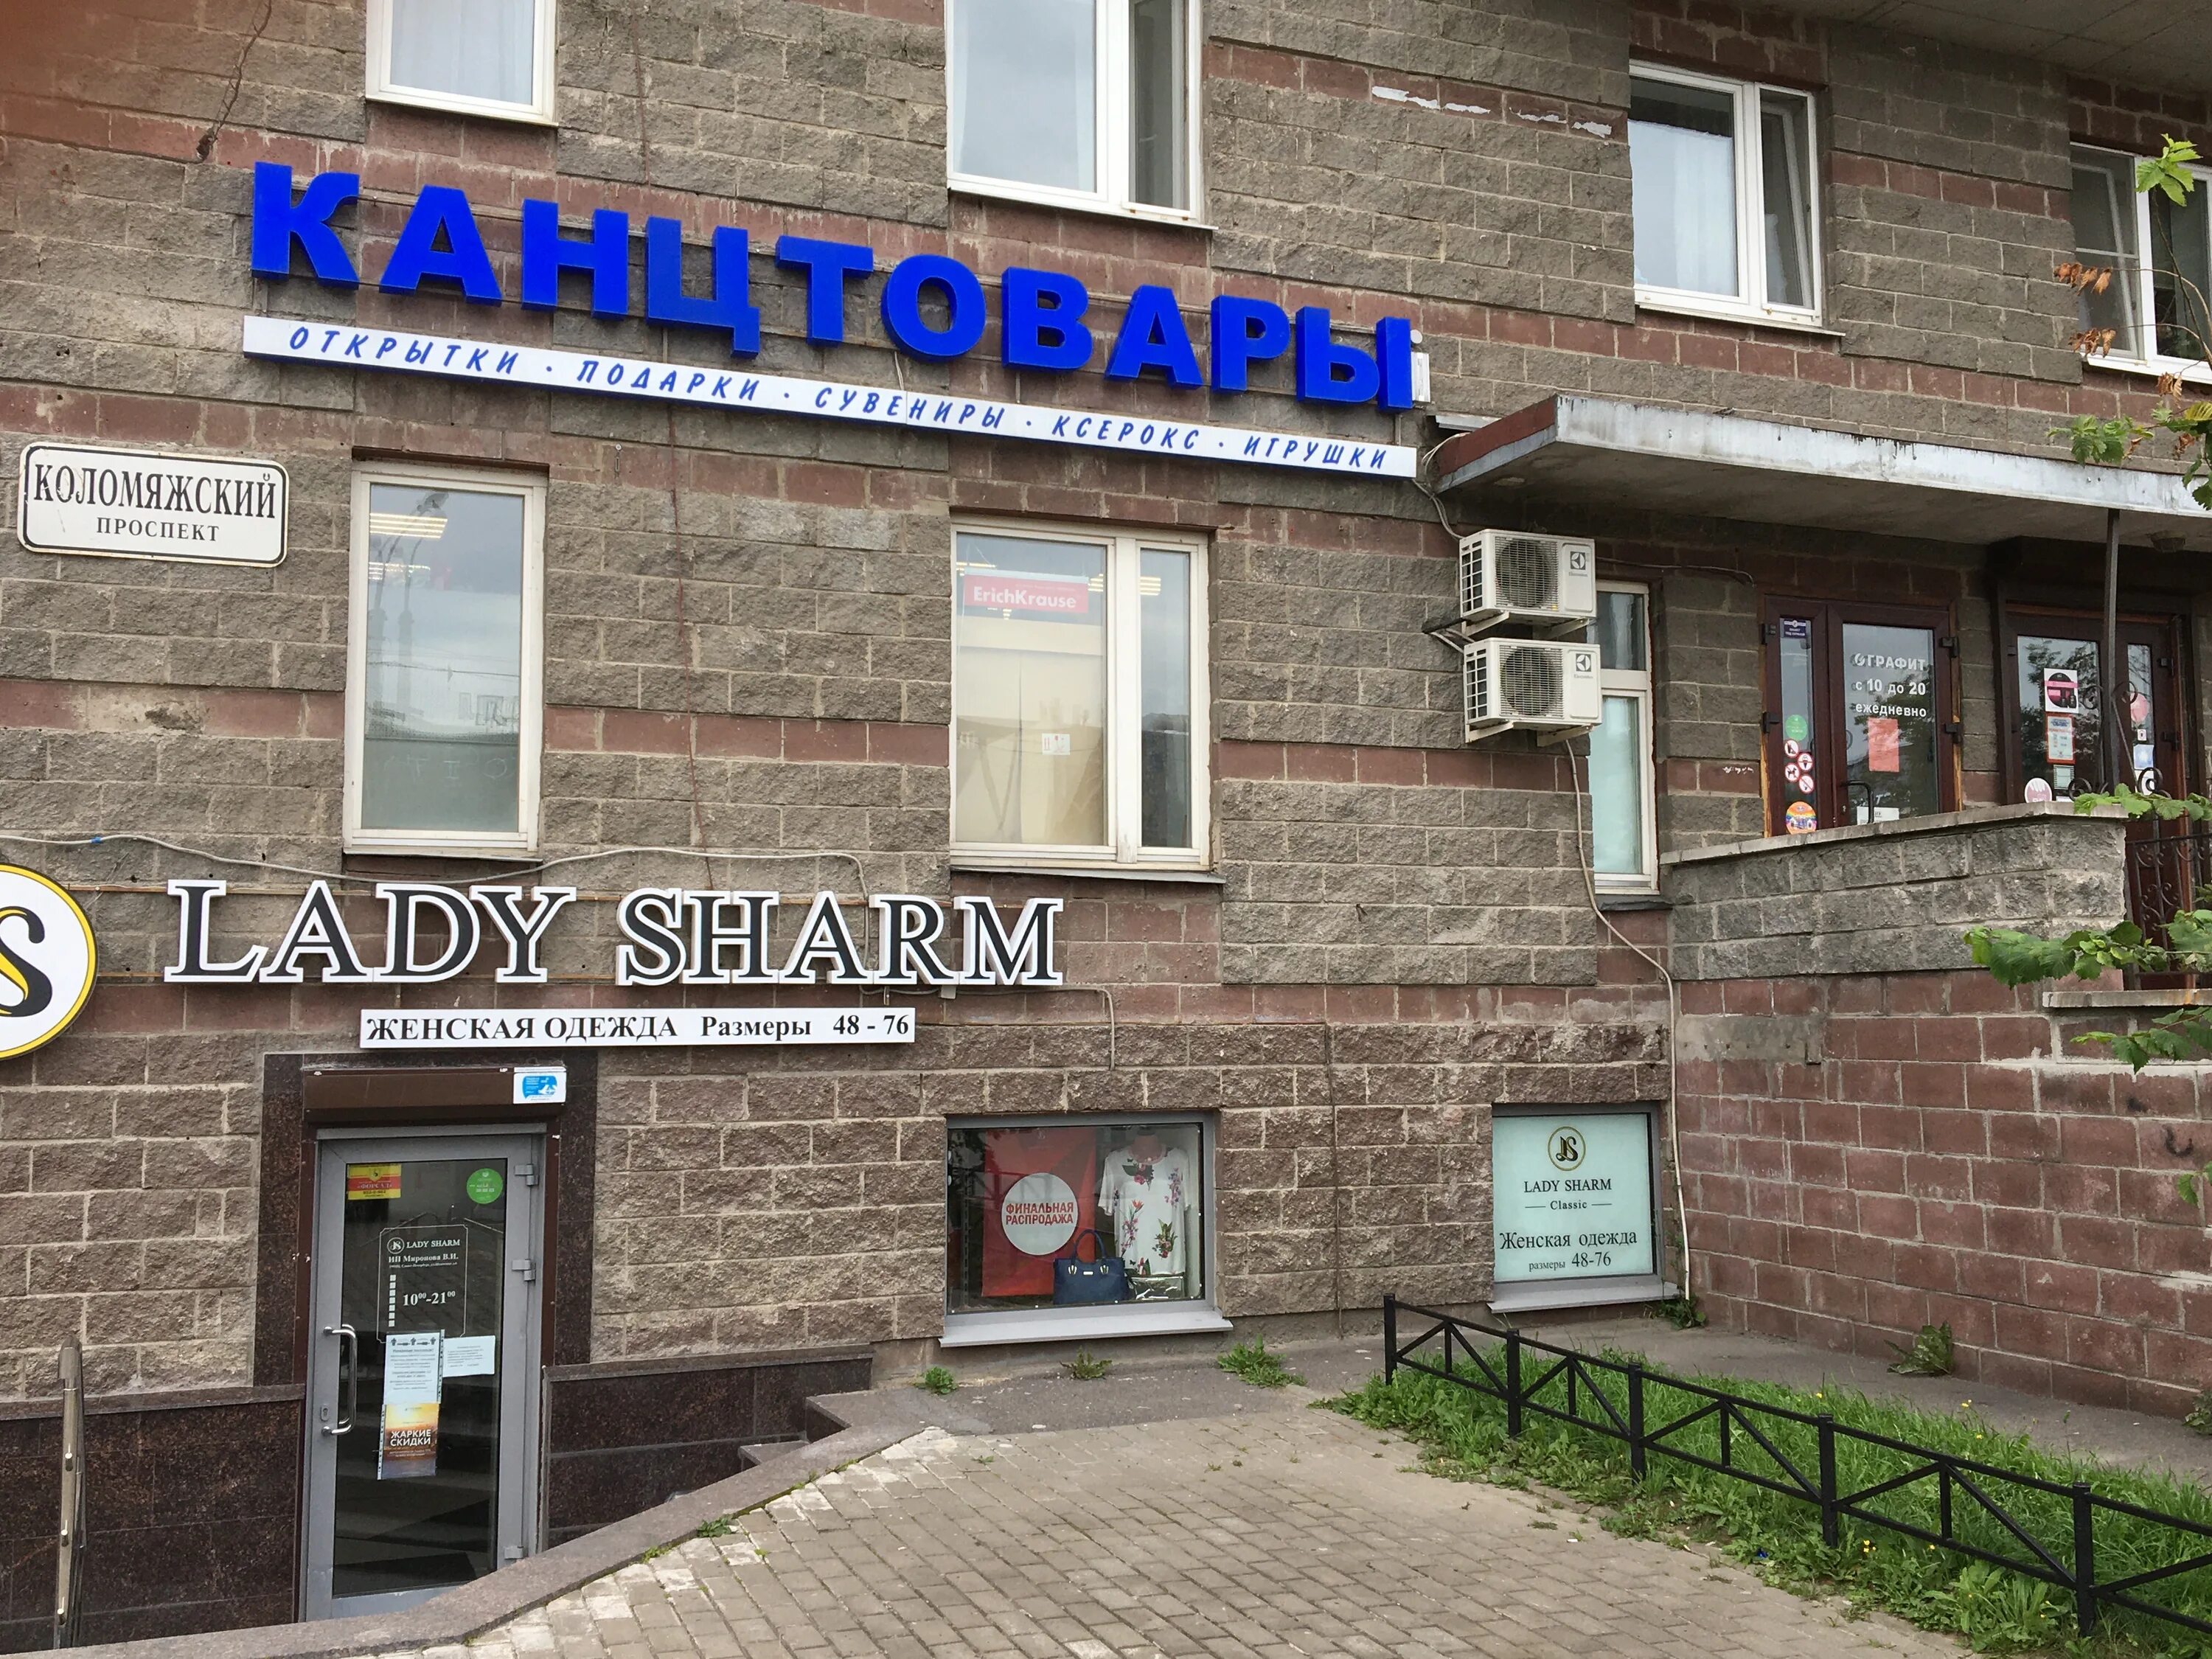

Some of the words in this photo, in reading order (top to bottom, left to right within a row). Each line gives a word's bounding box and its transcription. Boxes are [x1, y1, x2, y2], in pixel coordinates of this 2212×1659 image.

[251, 161, 1415, 413] КАНЦТОВАРЫ
[289, 327, 518, 374] ОТКРЫТКИ
[577, 360, 760, 401] ПОДАРКИ
[815, 387, 1005, 429] СУВЕНИРЫ
[1051, 415, 1201, 450] КСЕРОКС
[1244, 435, 1387, 469] ИГРУШКИ
[33, 463, 277, 519] КОЛОМЯЖСКИЙ
[97, 517, 220, 542] ПРОСПЕКТ
[973, 586, 1077, 608] ErichKrause
[1867, 653, 1927, 671] ГРАФИТ
[1855, 681, 1863, 691] с
[1867, 678, 1883, 692] 10
[1888, 684, 1905, 695] до
[1909, 681, 1927, 696] 20
[1855, 703, 1927, 717] ежедневно
[164, 879, 576, 984] LADY
[616, 887, 1064, 987] SHARM
[366, 1016, 536, 1040] ЖЕНСКАЯ
[546, 1015, 678, 1043] ОДЕЖДА
[701, 1015, 812, 1039] Размеры
[832, 1014, 860, 1036] 48
[883, 1013, 910, 1035] 76
[1523, 1180, 1561, 1193] LADY
[1565, 1178, 1612, 1192] SHARM
[1006, 1201, 1074, 1214] ФИНАЛЬНАЯ
[1550, 1200, 1587, 1210] Classic
[1005, 1214, 1074, 1226] РАСПРОДАЖА
[406, 1240, 430, 1249] LADY
[431, 1239, 461, 1248] SHARM
[1499, 1231, 1571, 1250] Женская
[1579, 1231, 1638, 1248] одежда
[1528, 1260, 1566, 1272] размеры
[1571, 1251, 1612, 1268] 48-76
[390, 1429, 431, 1439] ЖАРКИЕ
[390, 1437, 431, 1447] СКИДКИ
